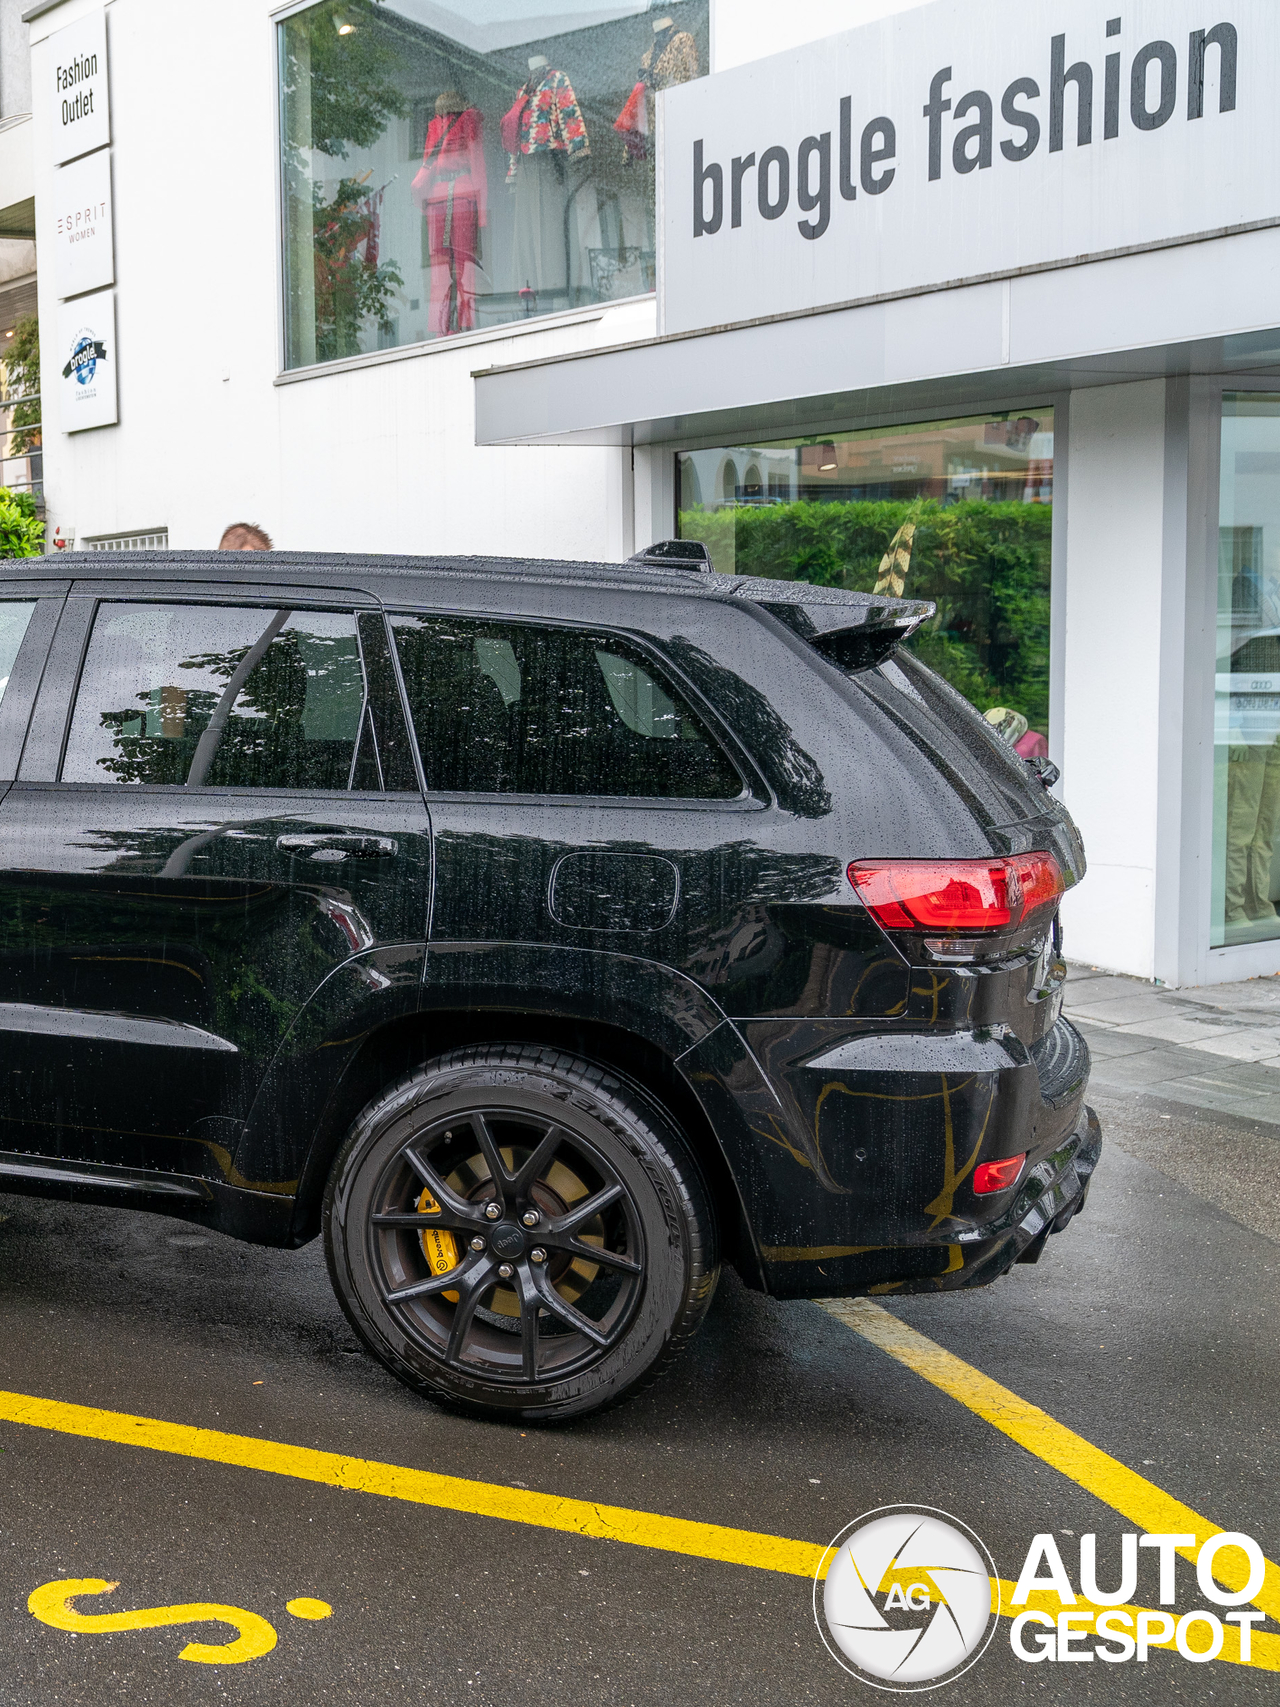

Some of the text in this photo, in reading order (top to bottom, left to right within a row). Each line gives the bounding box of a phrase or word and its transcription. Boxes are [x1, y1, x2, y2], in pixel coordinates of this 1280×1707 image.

[56, 53, 98, 93] Fashion
[61, 87, 94, 126] Outlet
[692, 17, 1238, 240] brogle fashion
[57, 202, 106, 234] ESPRIT
[69, 227, 95, 243] WOMEN
[431, 1229, 444, 1259] bremb
